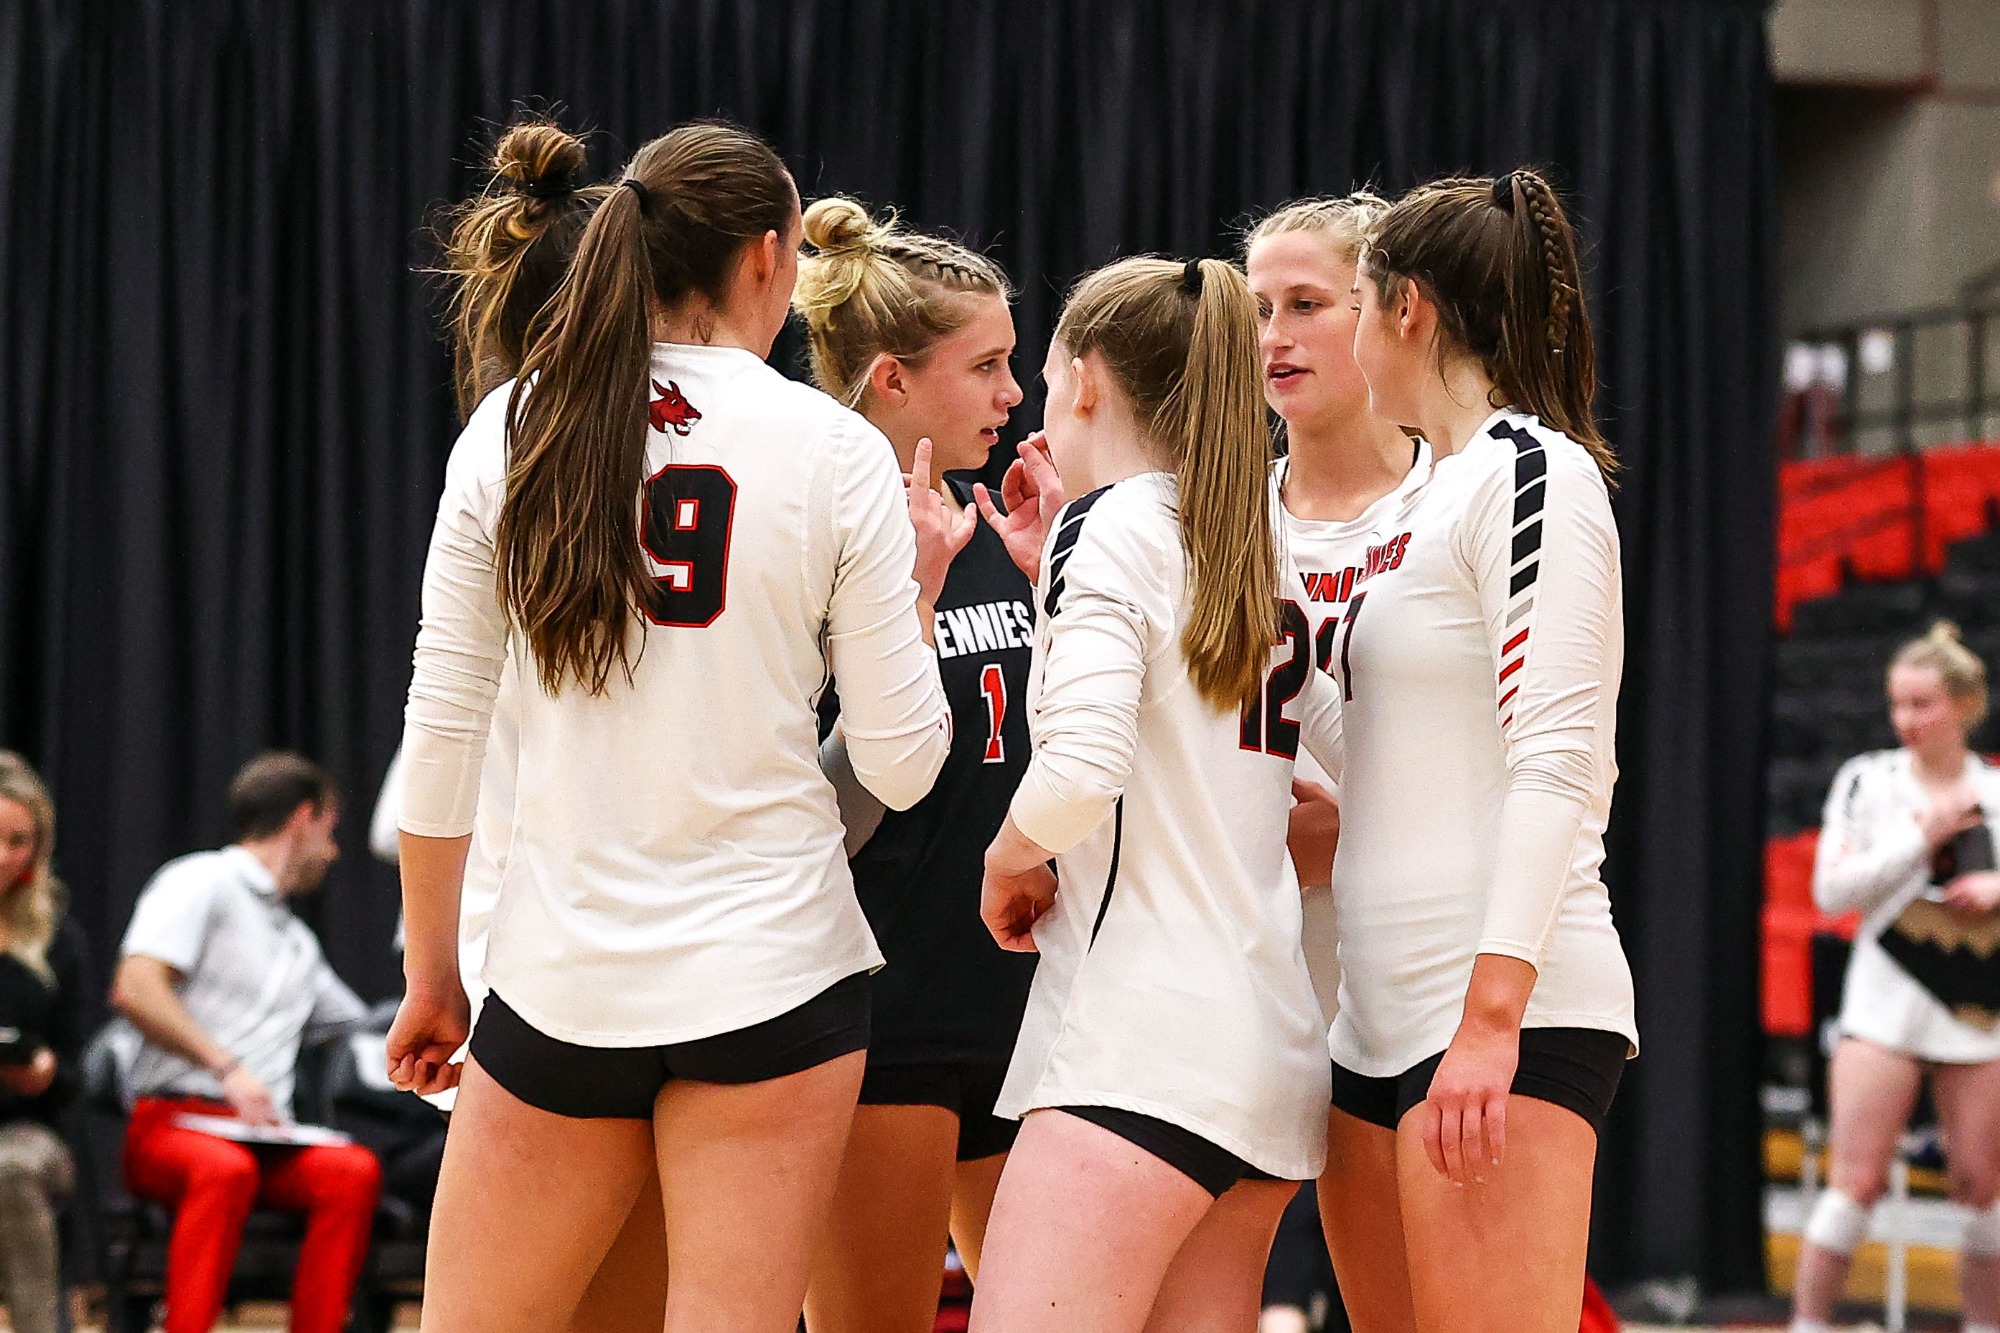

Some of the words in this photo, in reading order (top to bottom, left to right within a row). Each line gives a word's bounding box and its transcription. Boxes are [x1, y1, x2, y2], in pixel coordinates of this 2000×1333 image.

[637, 464, 738, 628] 9
[934, 601, 1035, 660] ENNIES
[980, 663, 1007, 764] 1
